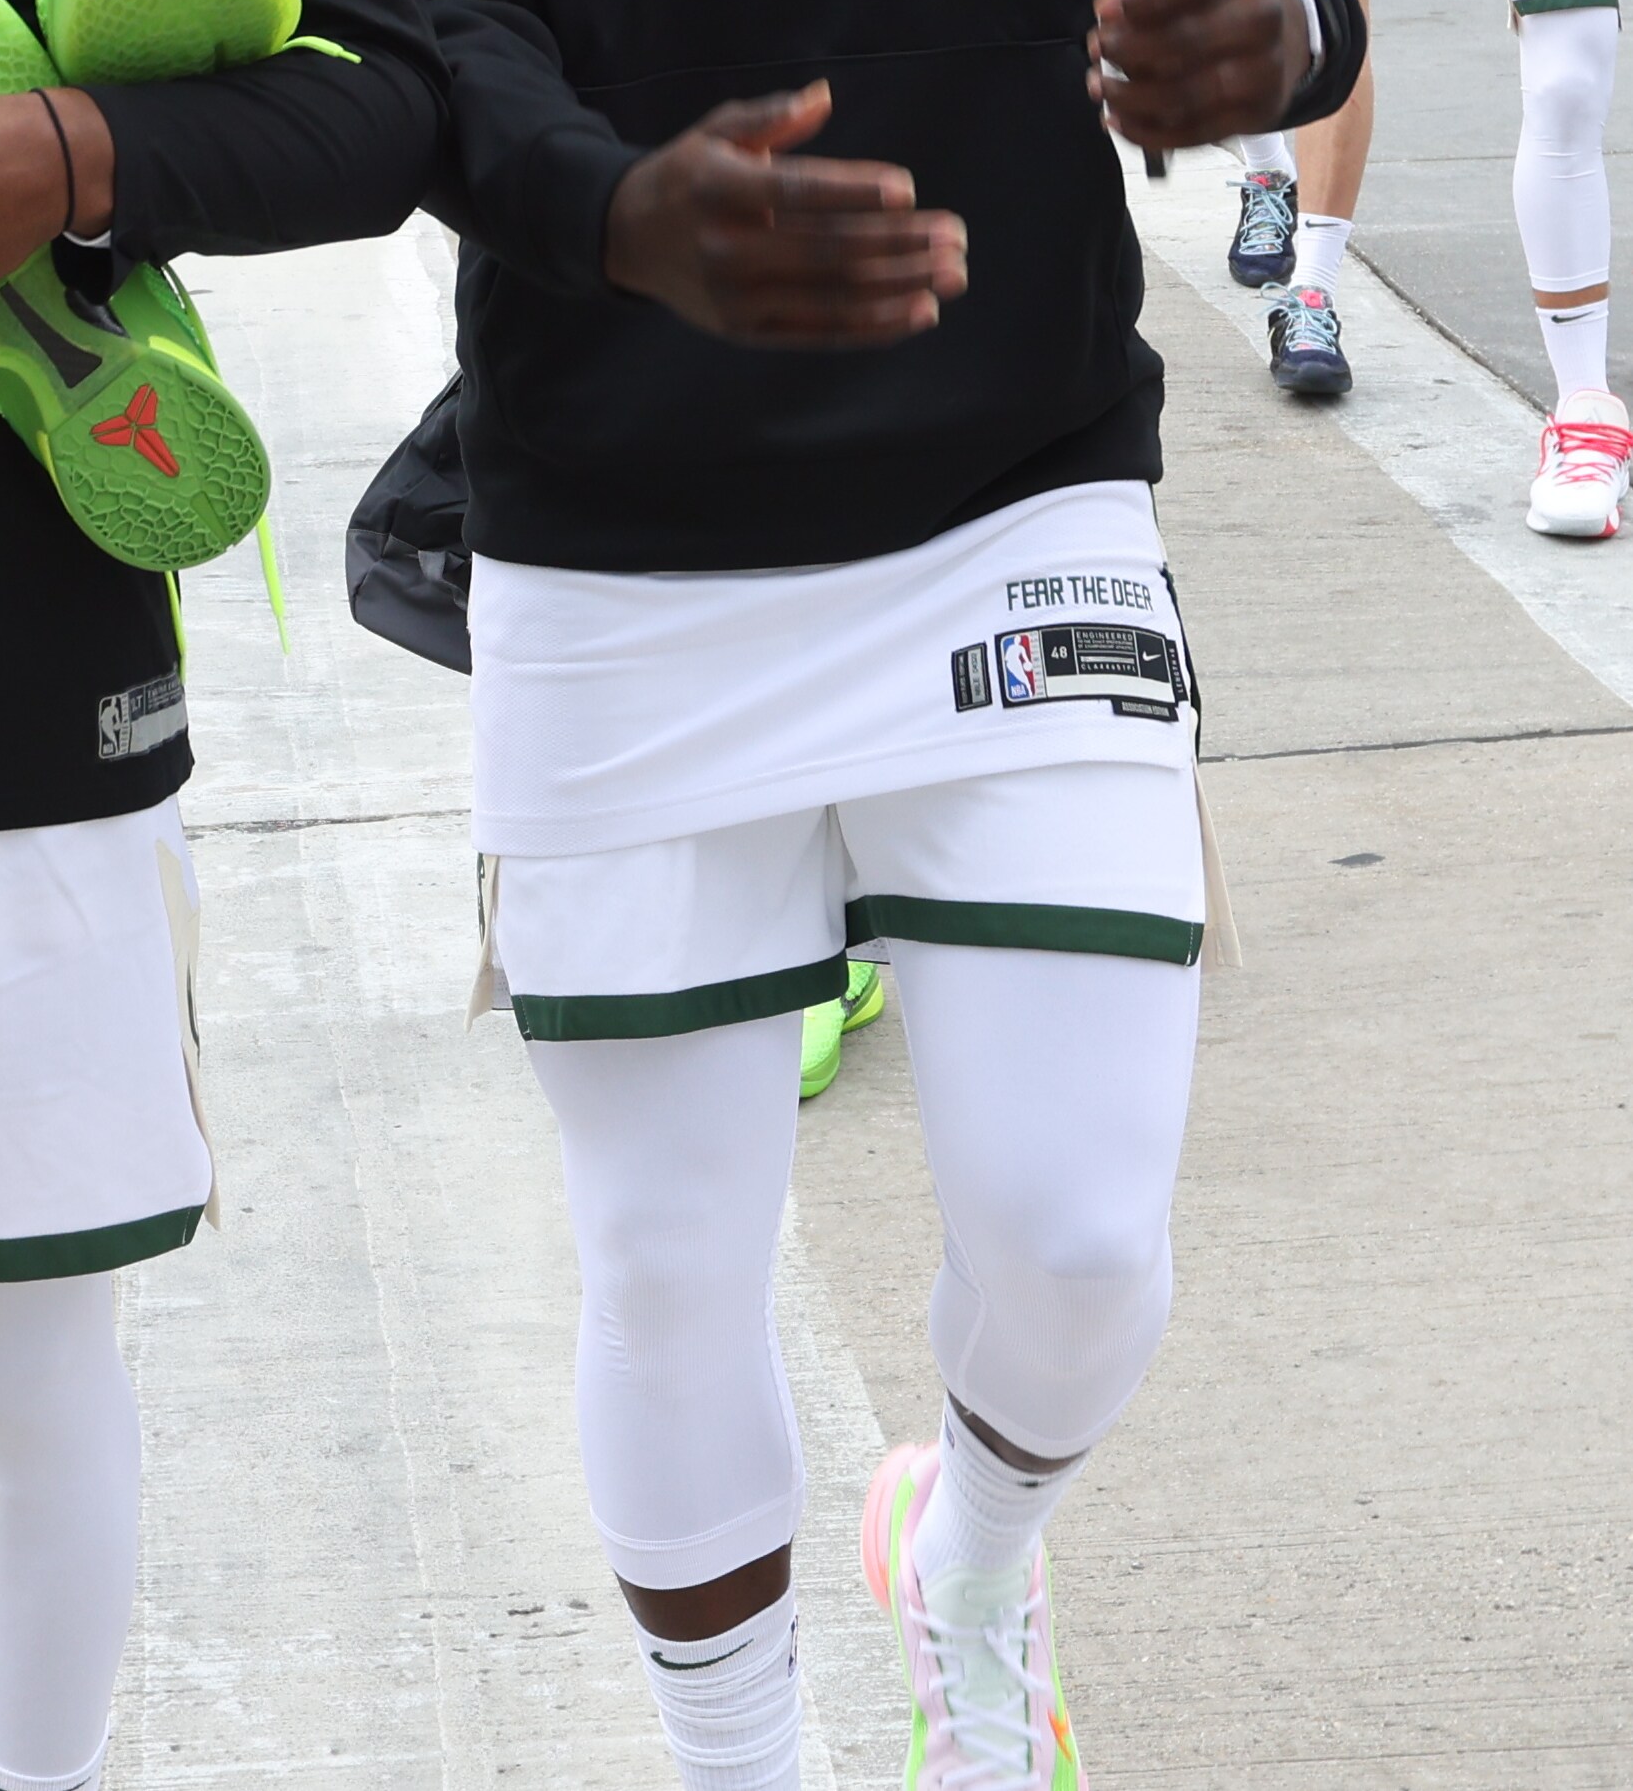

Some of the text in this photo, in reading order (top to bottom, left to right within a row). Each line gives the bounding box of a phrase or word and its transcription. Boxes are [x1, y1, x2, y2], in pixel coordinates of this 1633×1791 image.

[1006, 575, 1154, 611] FEAR THE DEER
[1076, 631, 1134, 642] ENGINEERED
[1051, 646, 1068, 659] 48
